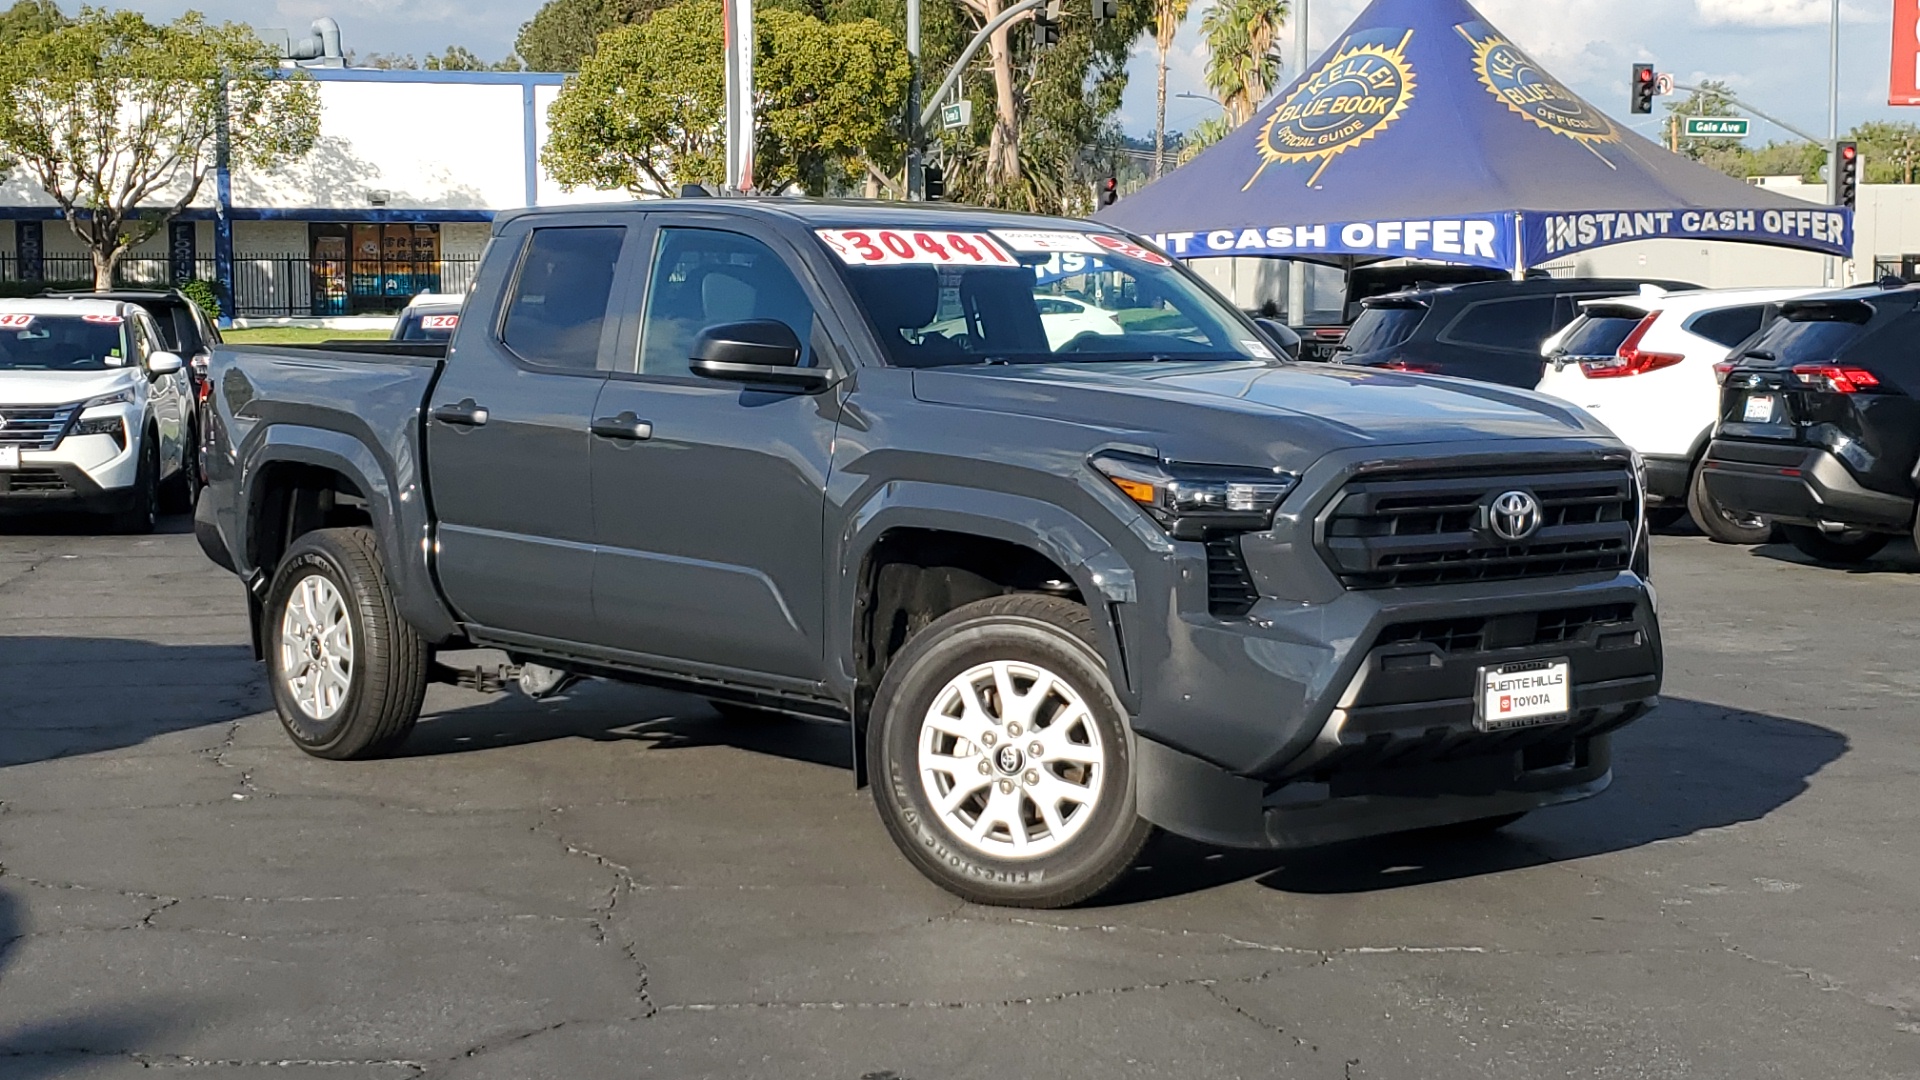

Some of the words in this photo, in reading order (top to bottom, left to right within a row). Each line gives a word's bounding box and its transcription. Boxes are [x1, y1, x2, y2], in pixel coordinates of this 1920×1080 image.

[1308, 59, 1396, 95] KELLEY
[1491, 50, 1526, 79] KELL
[1277, 97, 1333, 124] BLUE
[1329, 96, 1395, 115] BOOK
[1277, 126, 1316, 147] OFFICIAL
[1318, 120, 1365, 145] GUIDE
[1695, 122, 1718, 132] Gale
[1720, 122, 1740, 132] Ave
[1207, 224, 1326, 250] CASH
[1341, 220, 1496, 258] OFFER
[1545, 211, 1673, 253] INSTANT
[1681, 210, 1756, 232] CASH
[1762, 210, 1844, 245] OFFER
[1312, 345, 1336, 358] Je
[1505, 662, 1547, 673] TOYOTA
[1486, 678, 1530, 692] PUENTE
[1531, 674, 1563, 687] HILLS
[1513, 693, 1551, 707] TOYOTA
